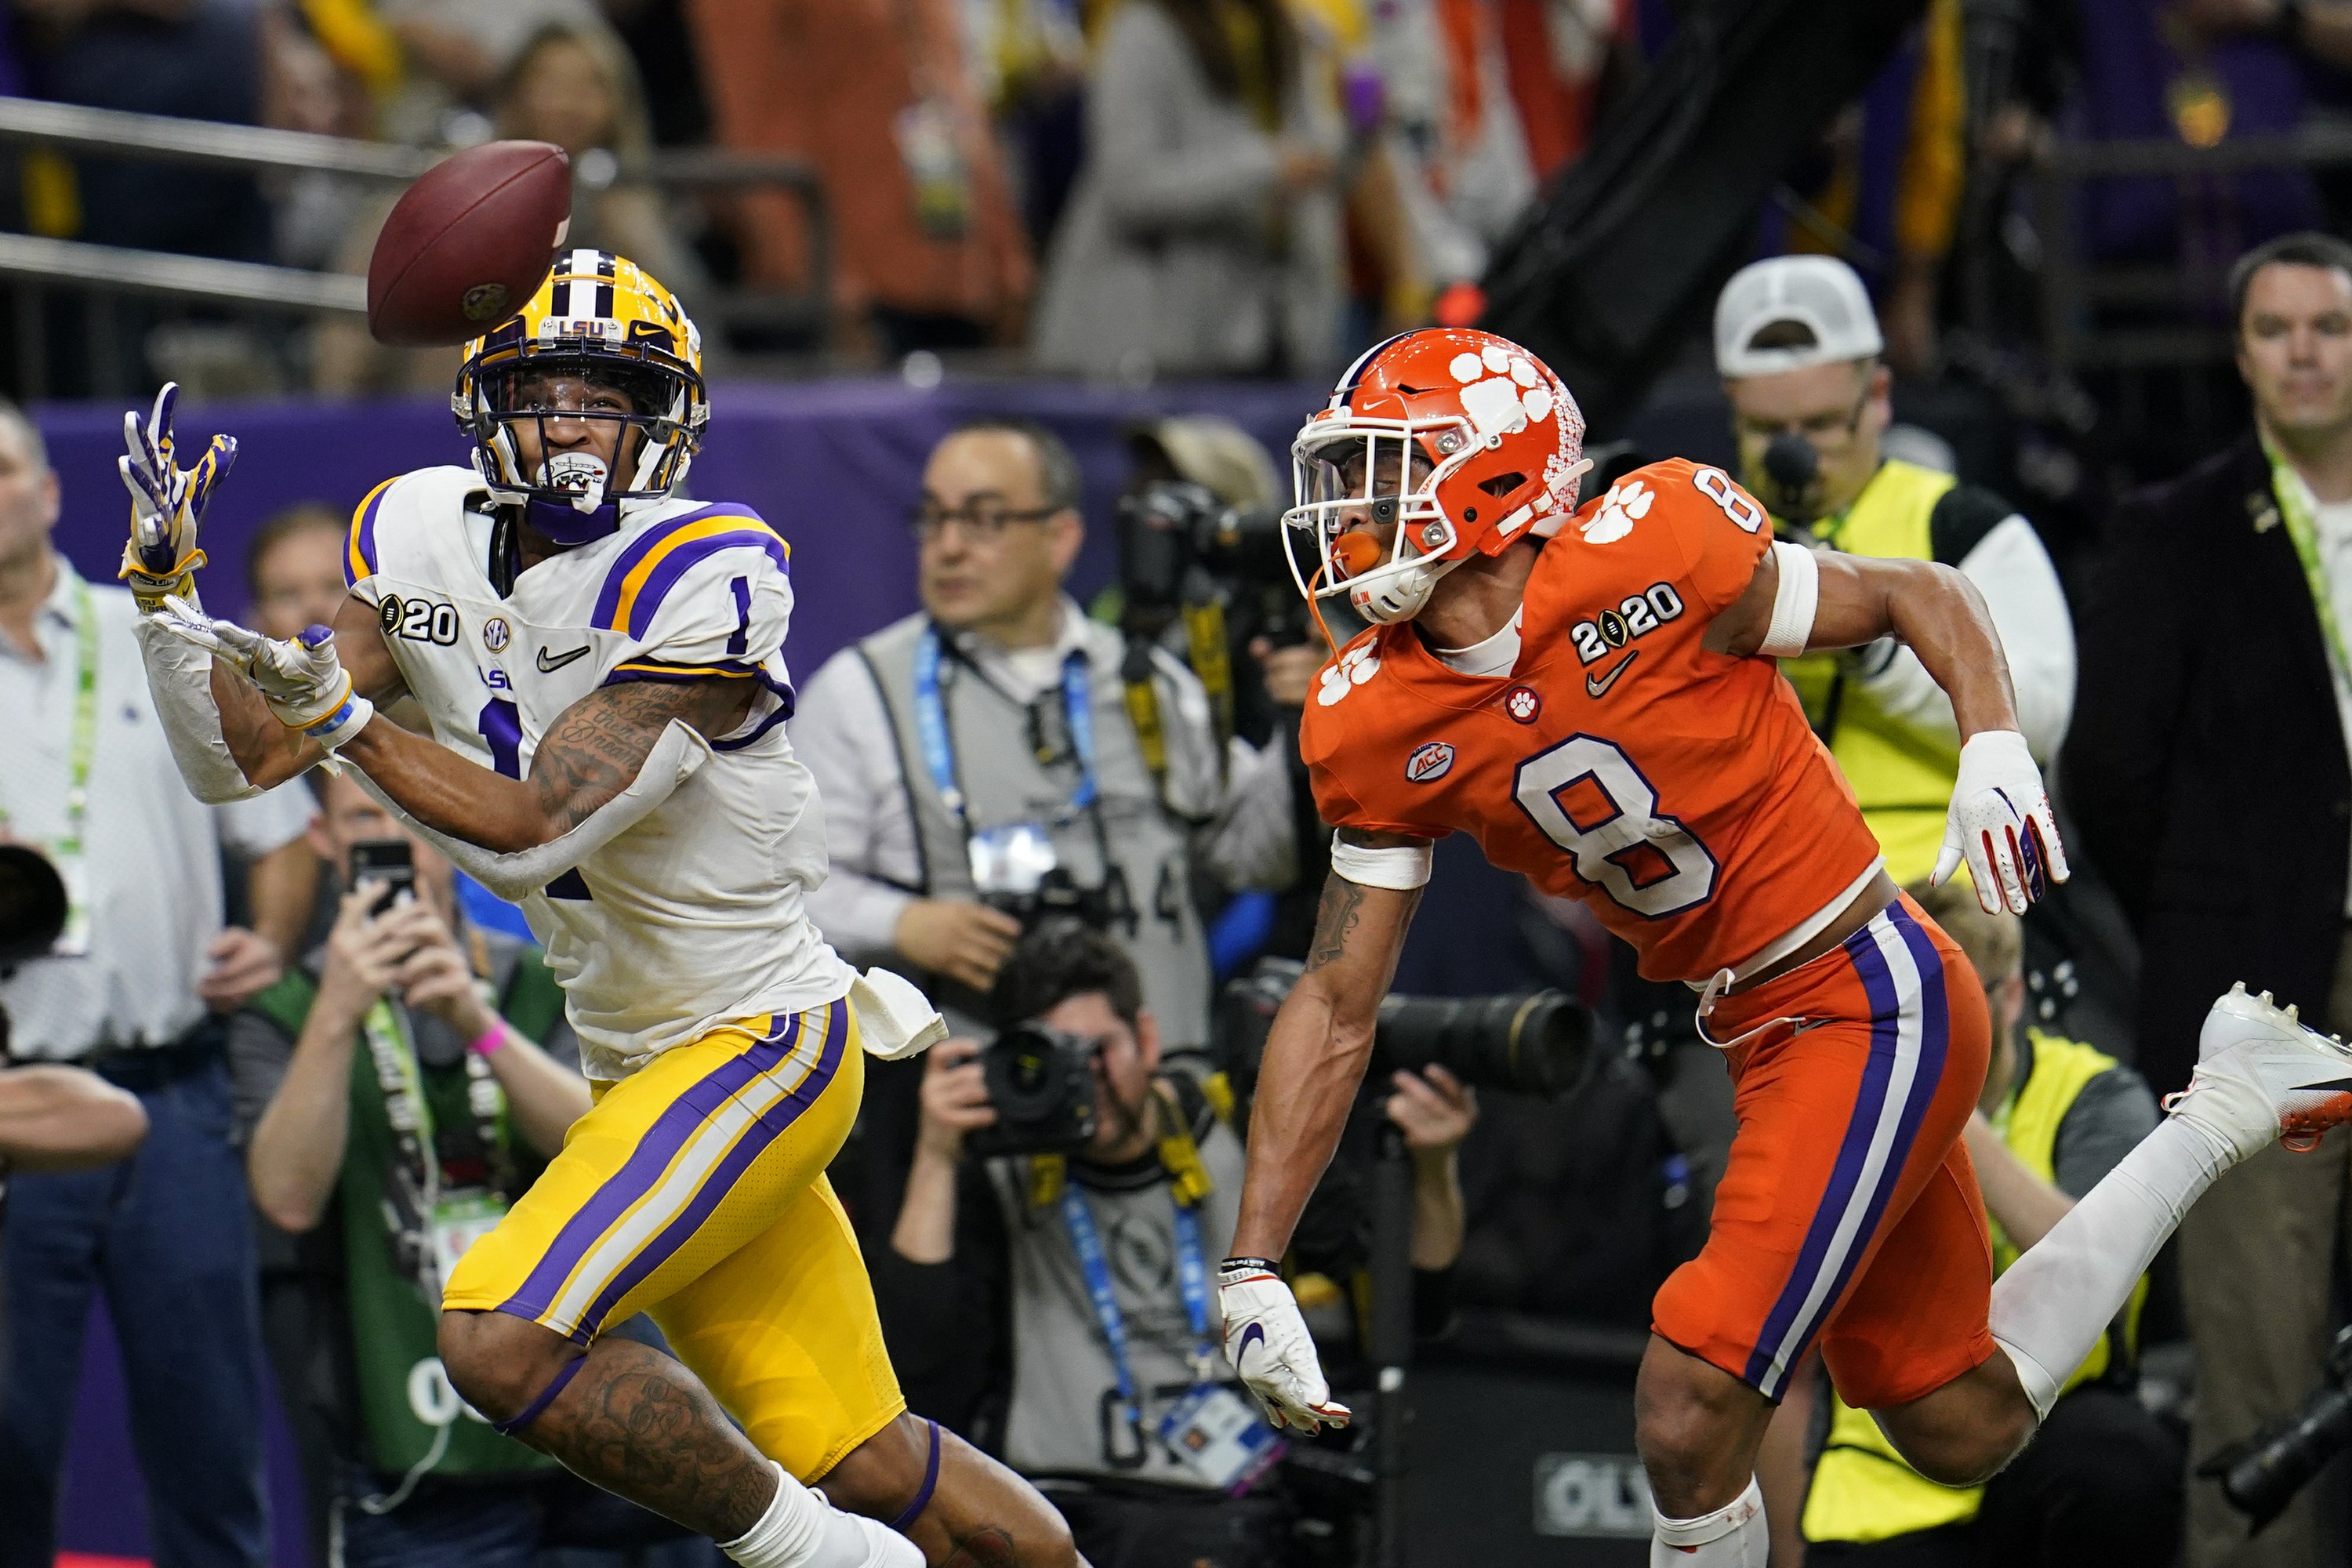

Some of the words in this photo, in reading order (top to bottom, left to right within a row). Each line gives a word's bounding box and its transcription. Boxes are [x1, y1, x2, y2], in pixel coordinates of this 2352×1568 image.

[559, 321, 604, 337] LSU
[1693, 467, 1762, 535] 8
[485, 618, 510, 652] SEC
[726, 575, 751, 655] 1
[1414, 744, 1447, 776] ACC
[1510, 731, 1721, 922] 8
